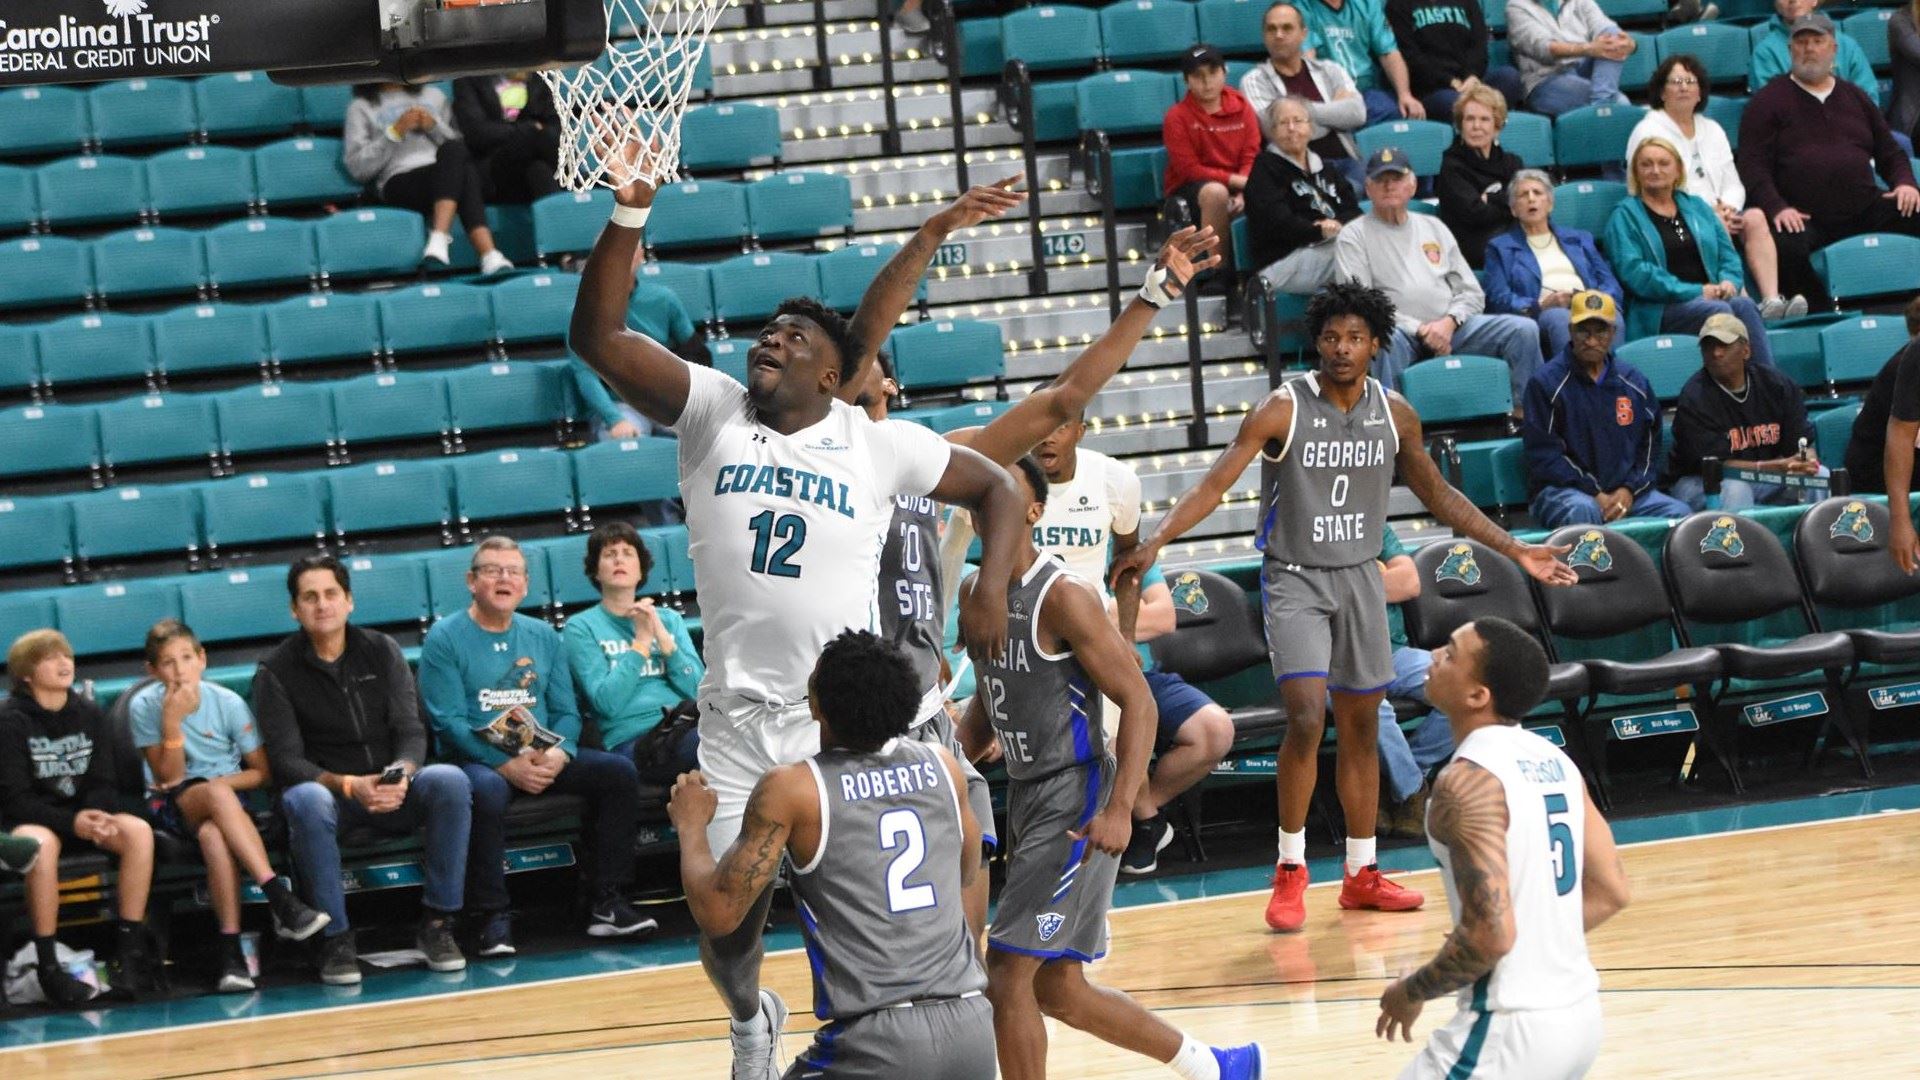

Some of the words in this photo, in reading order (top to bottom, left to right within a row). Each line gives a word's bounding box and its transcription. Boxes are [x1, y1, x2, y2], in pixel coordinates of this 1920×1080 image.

[136, 14, 210, 44] Trust
[0, 51, 67, 73] EDERAL
[74, 47, 135, 69] CREDIT
[143, 44, 210, 66] UNION
[1045, 236, 1067, 255] 14
[1616, 396, 1634, 426] S
[1303, 440, 1384, 467] GEORGIA
[714, 464, 855, 519] COASTAL
[1331, 474, 1349, 507] 0
[1313, 513, 1364, 542] STATE
[749, 510, 807, 578] 12
[841, 762, 938, 801] ROBERTS
[878, 808, 938, 913] 2
[1543, 793, 1577, 897] 5
